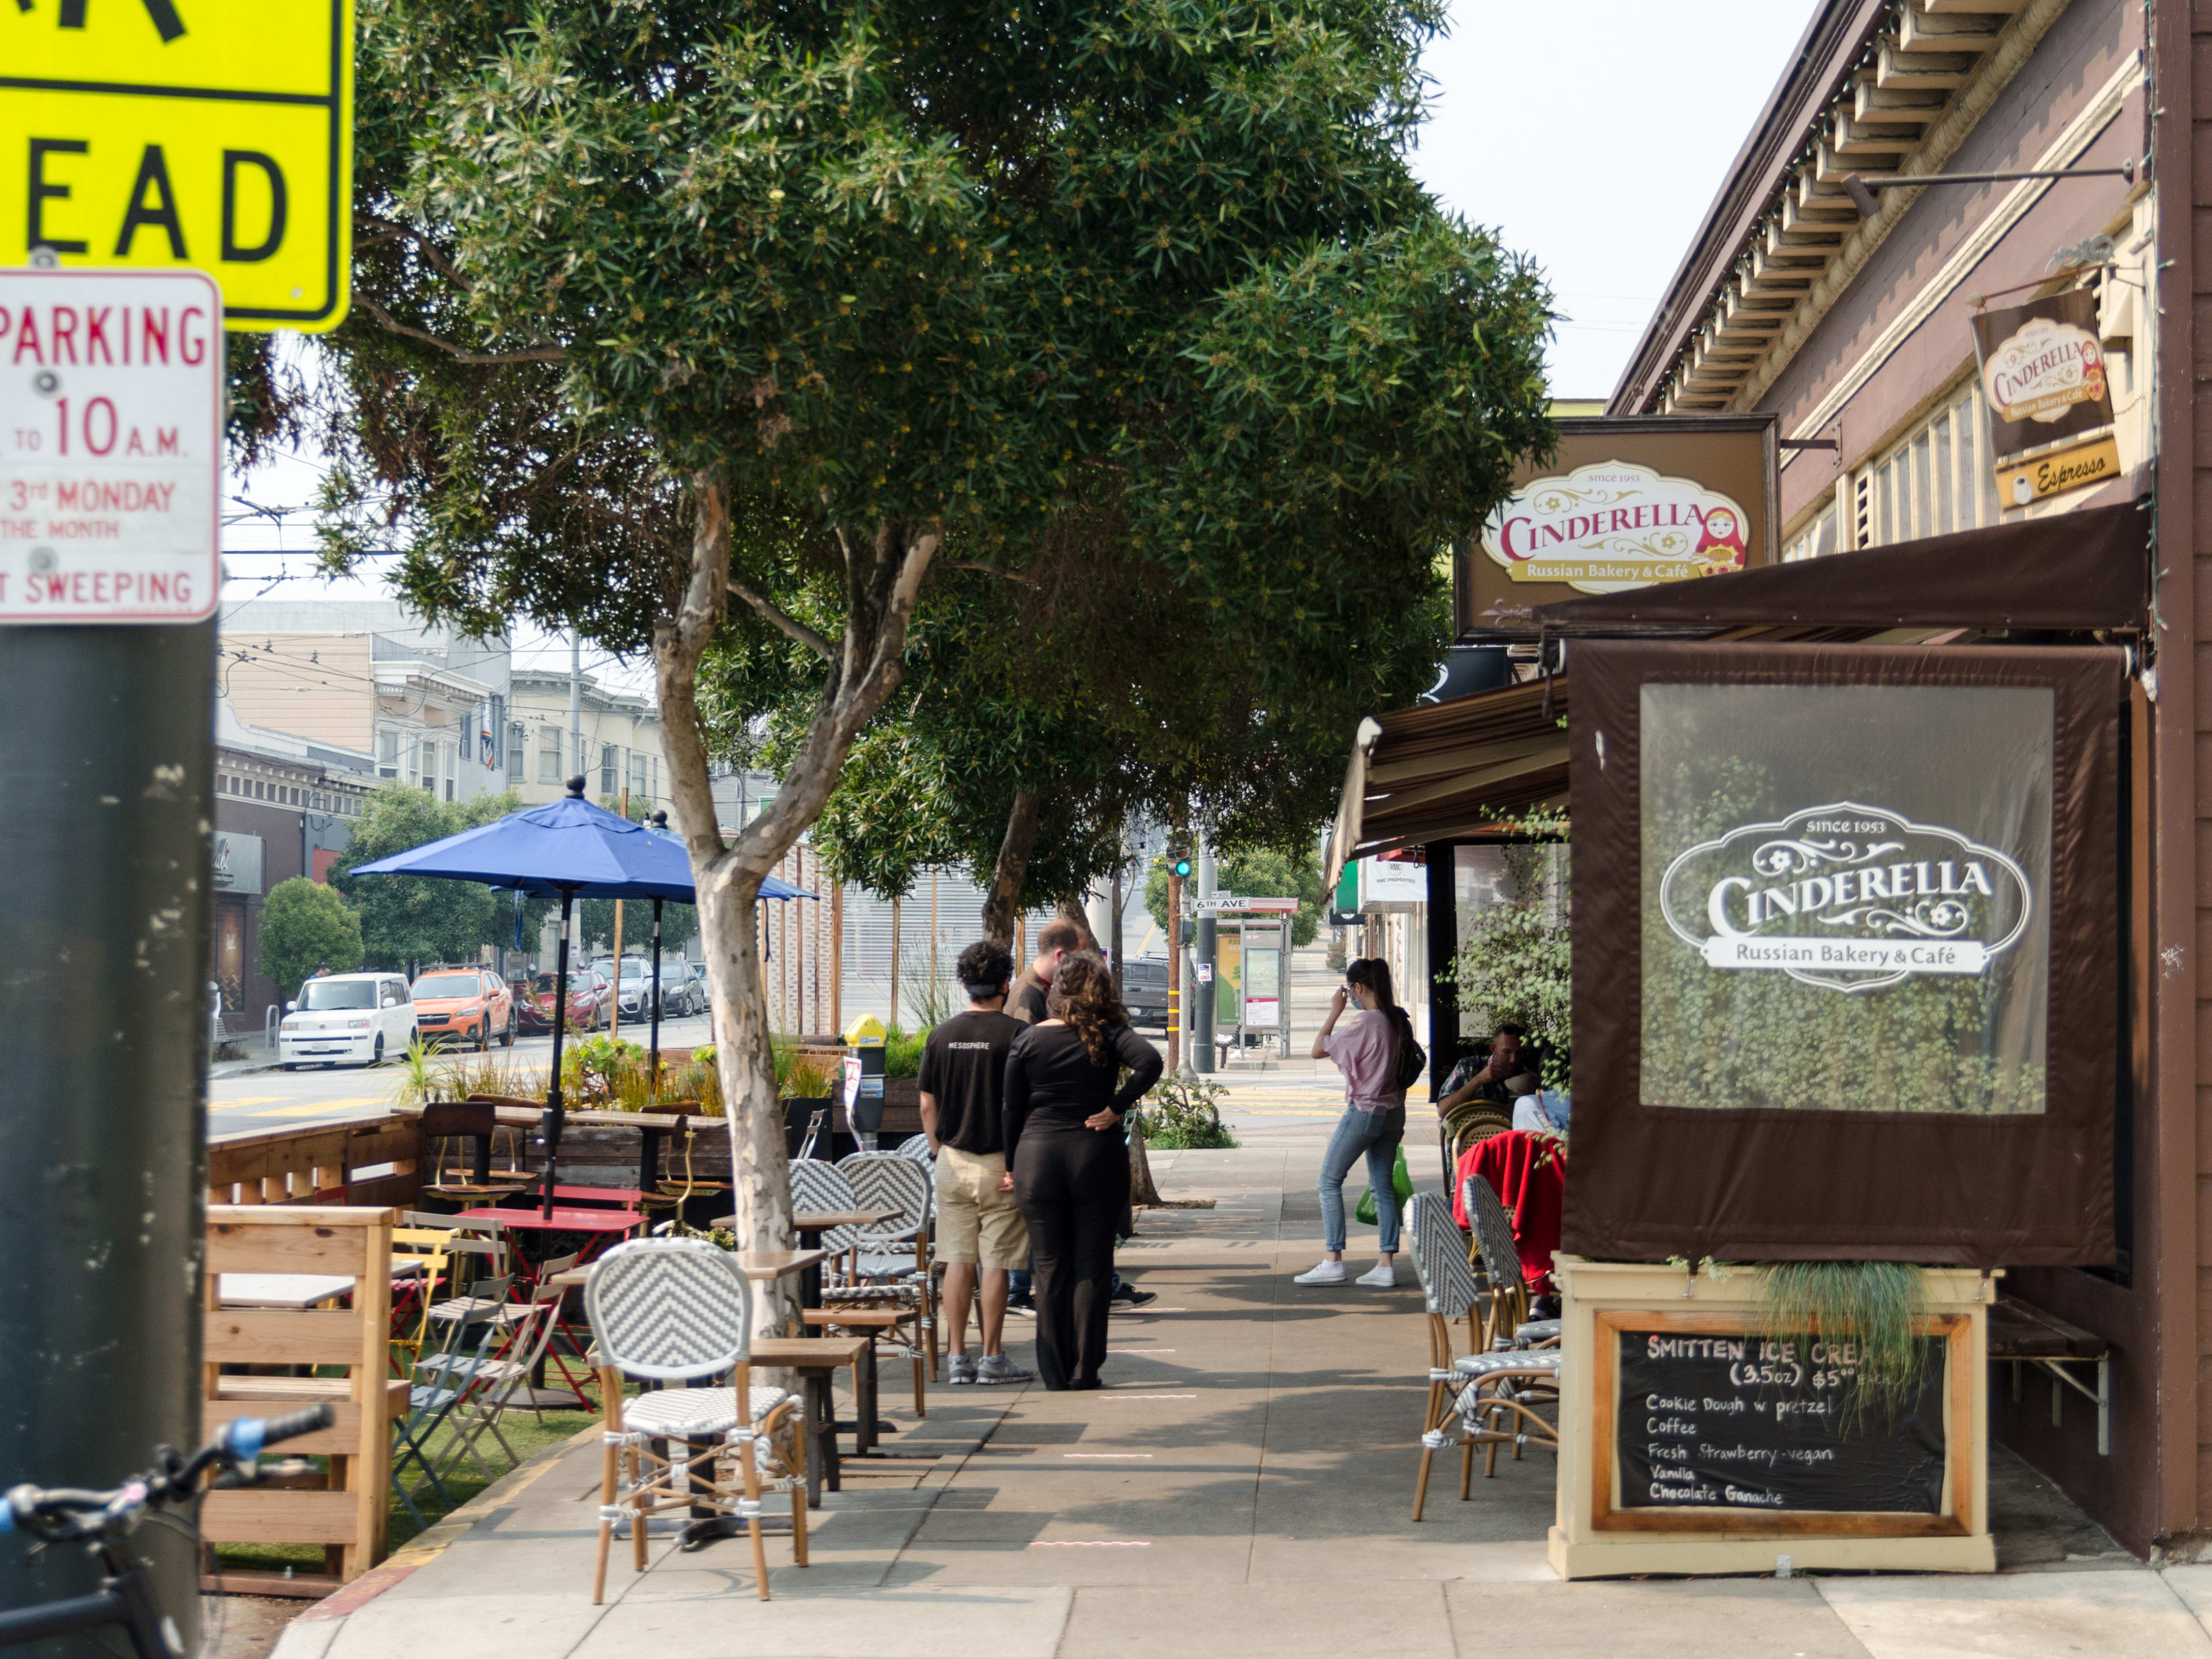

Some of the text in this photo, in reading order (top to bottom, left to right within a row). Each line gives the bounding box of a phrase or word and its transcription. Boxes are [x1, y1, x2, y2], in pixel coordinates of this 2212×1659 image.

[28, 137, 288, 263] EAD
[1994, 341, 2083, 407] CINDERELLA
[2010, 404, 2036, 418] Russian
[2038, 396, 2061, 409] Bakery
[15, 396, 190, 458] TO 10 A.M.
[1619, 475, 1640, 483] 1953
[2037, 456, 2106, 494] Espresso
[10, 480, 176, 513] 3rd MONDAY
[0, 520, 119, 539] THE MONTH
[1500, 503, 1704, 561] CINDERELLA
[1527, 563, 1688, 579] Russian Bakery & Café
[25, 571, 192, 604] SWEEPING
[1806, 820, 1886, 834] since 1953
[1221, 900, 1246, 908] AVE
[1708, 861, 1993, 938] CINDERELLA
[1736, 944, 1956, 967] Russian Bakery & Café
[948, 1041, 990, 1050] MESOSPHERE
[1647, 1335, 1745, 1361] SMITTEN
[1759, 1341, 1796, 1363] ICE
[1703, 1396, 1745, 1416] Dough
[1775, 1395, 1833, 1422] pretzel
[1646, 1416, 1697, 1435] Coffee
[1648, 1442, 1688, 1459] Fresh
[1699, 1443, 1777, 1468] Strawberry
[1650, 1464, 1696, 1481] Vanilla
[1649, 1482, 1784, 1505] Chocolate Ganache
